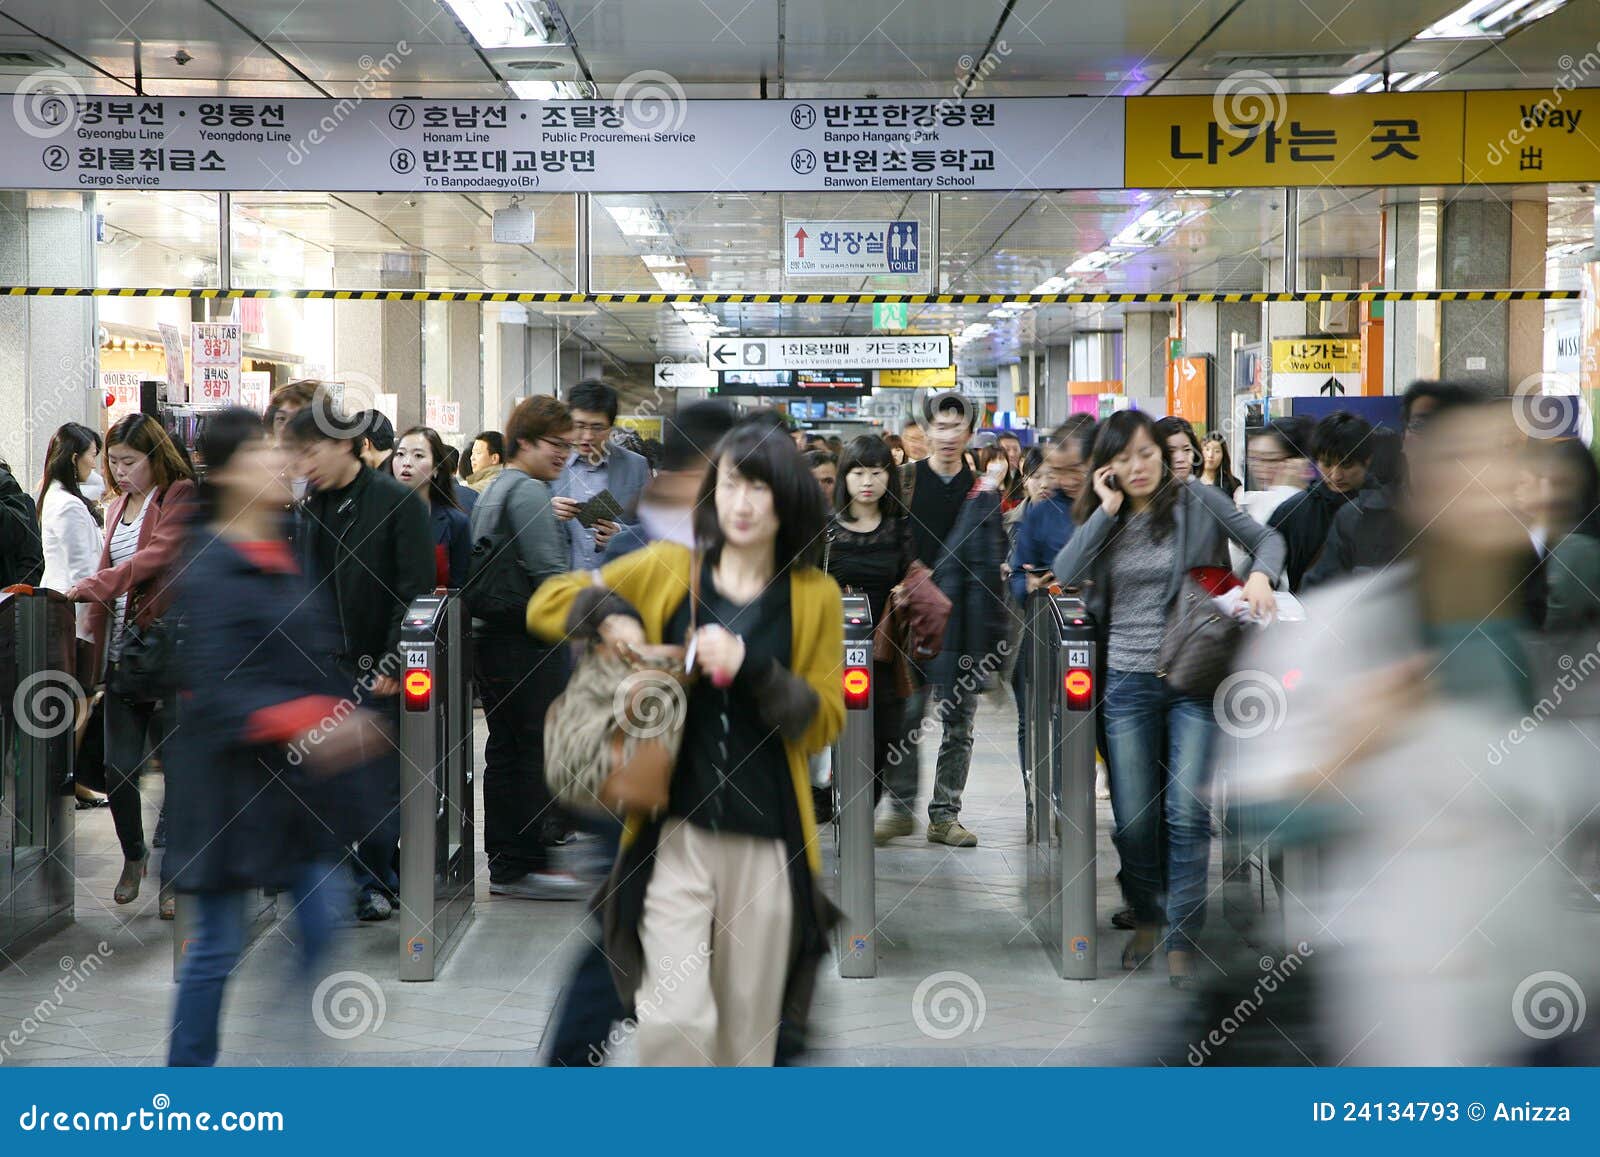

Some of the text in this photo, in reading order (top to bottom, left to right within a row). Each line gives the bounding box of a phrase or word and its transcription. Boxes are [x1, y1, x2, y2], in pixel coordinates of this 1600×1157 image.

[77, 102, 164, 126] 경부선
[199, 103, 285, 127] 영동선
[423, 105, 507, 128] 호남선
[542, 106, 624, 128] 조달청
[824, 104, 995, 127] 반포한강공원
[1520, 105, 1582, 133] Way
[77, 129, 164, 141] Gyeongbu Line
[199, 130, 291, 143] Yeongdong Line
[423, 132, 490, 143] Honam Line
[542, 132, 696, 143] Public Procurement Service
[824, 131, 939, 144] Banpo Hangang Park
[1170, 119, 1421, 164] 나가는 곳
[78, 148, 226, 171] 화물취급소
[423, 150, 595, 172] 반포대교방면
[824, 149, 995, 172] 반원초등학교
[1520, 146, 1542, 170] 出
[79, 174, 160, 187] Cargo Service
[423, 175, 539, 188] To Banpodaegyo(Br)
[824, 175, 975, 188] Banwon Elementary School
[820, 231, 884, 255] 화장실
[890, 261, 916, 271] TOILET
[222, 327, 236, 339] TAB
[781, 342, 942, 355] 1회용발매 카드충전기
[1291, 344, 1348, 359] 나가는
[784, 358, 809, 366] Ticket
[812, 358, 840, 366] Vending
[912, 357, 937, 365] Device
[1291, 362, 1310, 370] Way
[409, 653, 424, 664] 44
[849, 652, 864, 663] 42
[1071, 653, 1086, 664] 41
